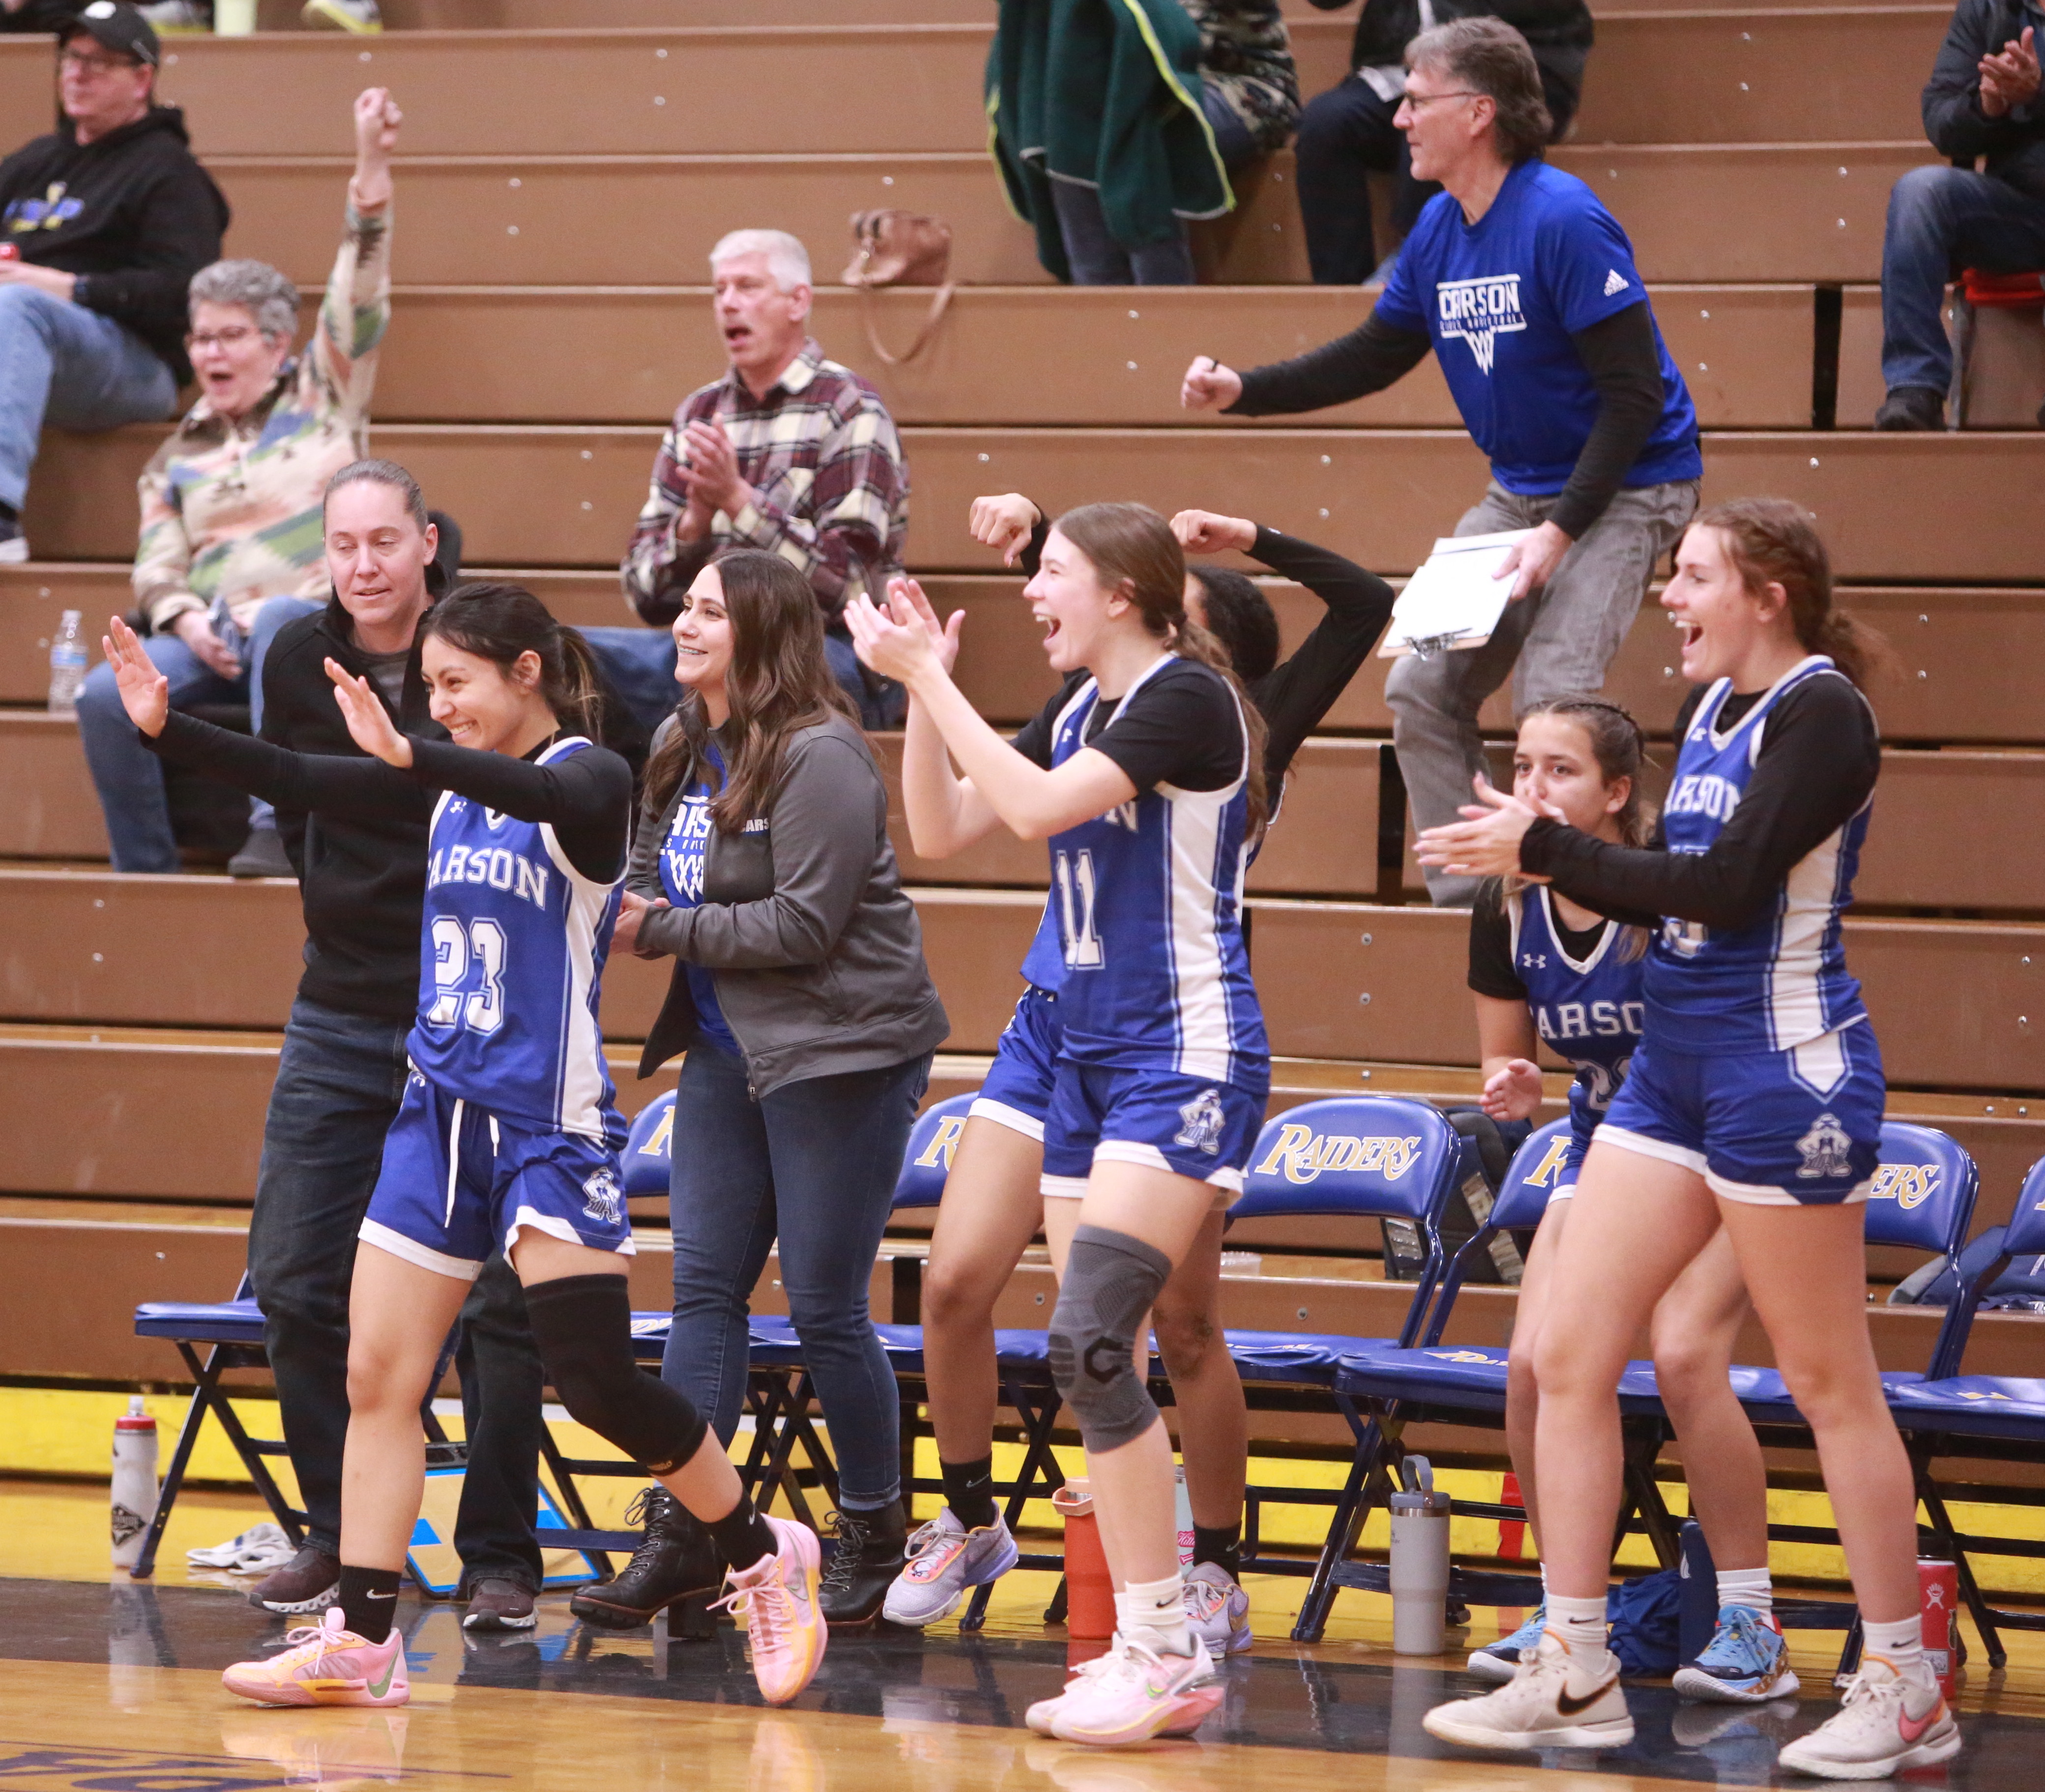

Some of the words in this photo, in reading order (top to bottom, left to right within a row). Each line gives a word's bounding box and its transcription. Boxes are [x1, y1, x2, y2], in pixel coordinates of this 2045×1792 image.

[1438, 282, 1521, 321] CARSON
[740, 818, 770, 832] ARS
[428, 845, 548, 911] ARSON
[1056, 849, 1105, 970] 11
[427, 915, 507, 1036] 23
[1528, 1000, 1645, 1040] ARSO
[1254, 1123, 1422, 1185] RAIDERS
